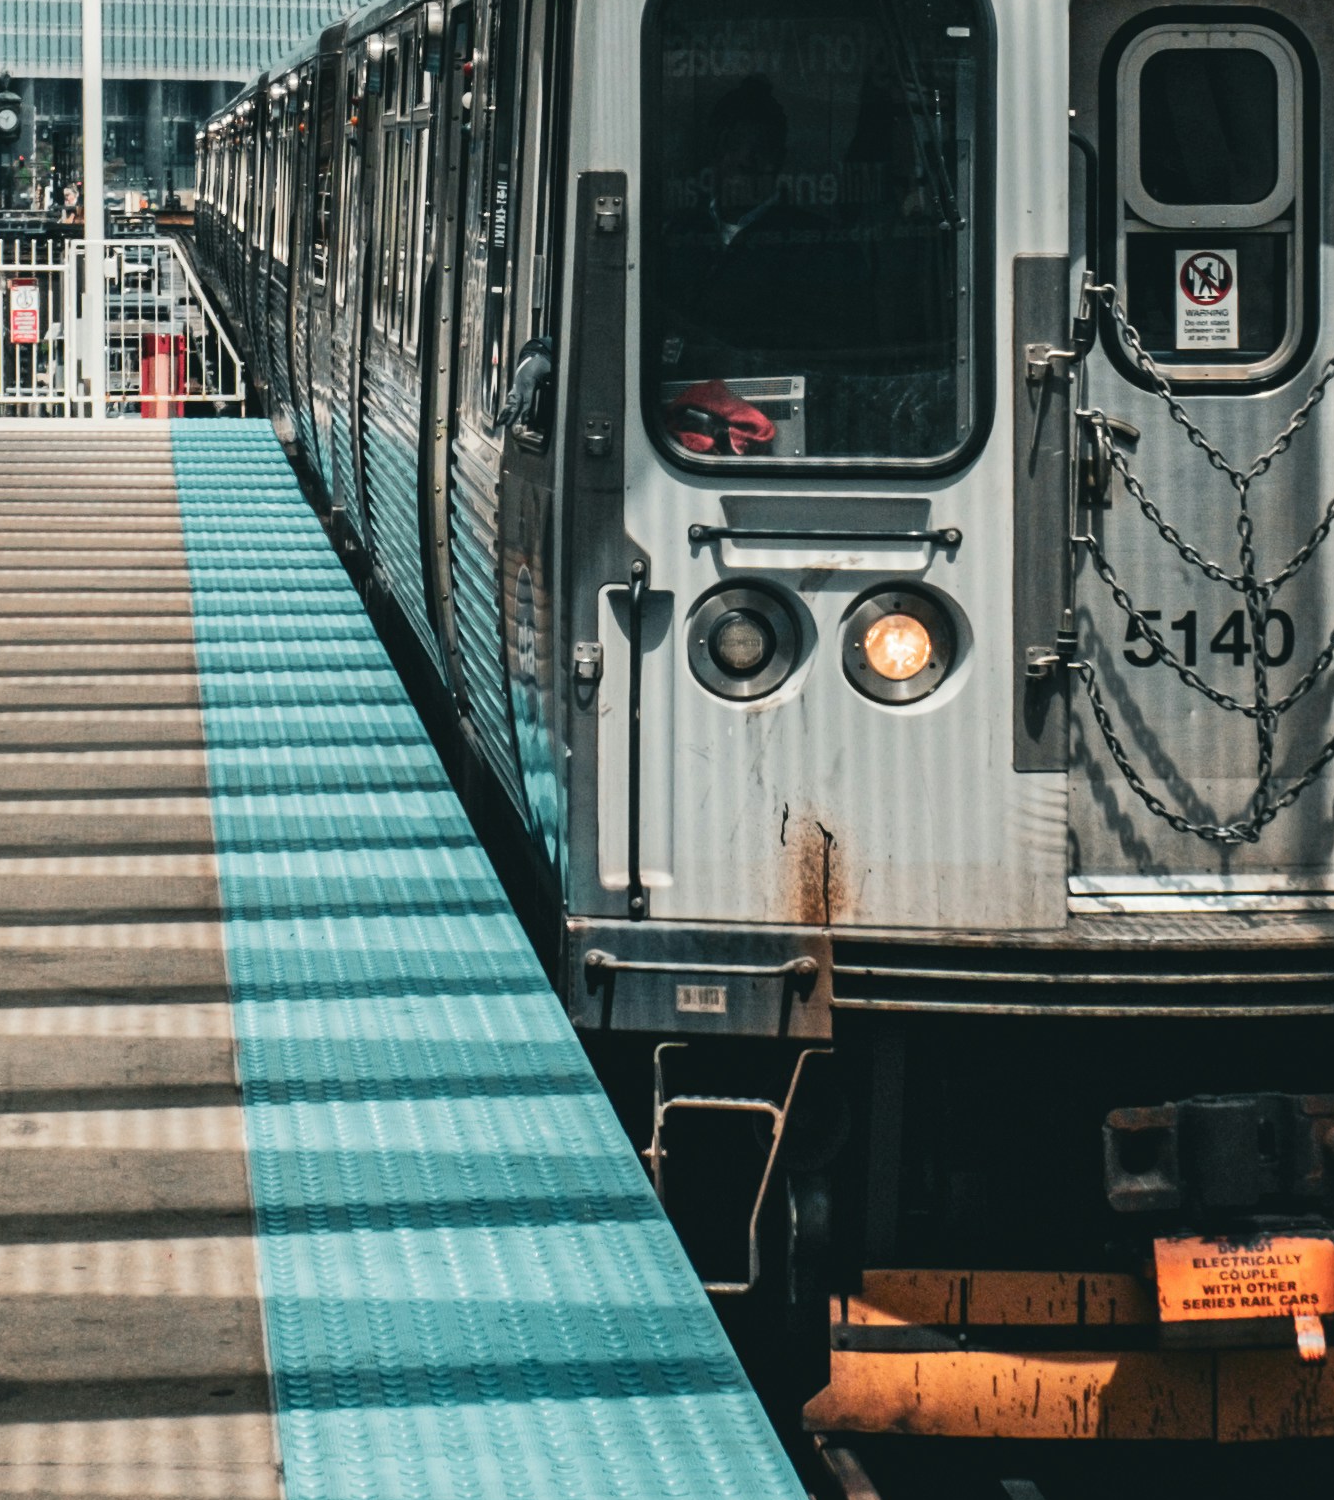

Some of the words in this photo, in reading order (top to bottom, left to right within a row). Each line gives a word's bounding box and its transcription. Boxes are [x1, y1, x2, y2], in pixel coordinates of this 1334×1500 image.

[1185, 308, 1229, 317] WARNING
[1123, 609, 1295, 667] 5140
[1192, 1254, 1302, 1269] ELECTRICALLY
[1219, 1268, 1279, 1281] COUPLE
[1203, 1282, 1242, 1295] WITH
[1246, 1281, 1296, 1293] OTHER
[1182, 1297, 1236, 1310] SERIES
[1240, 1295, 1275, 1307] RAIL
[1279, 1293, 1320, 1306] CARS
